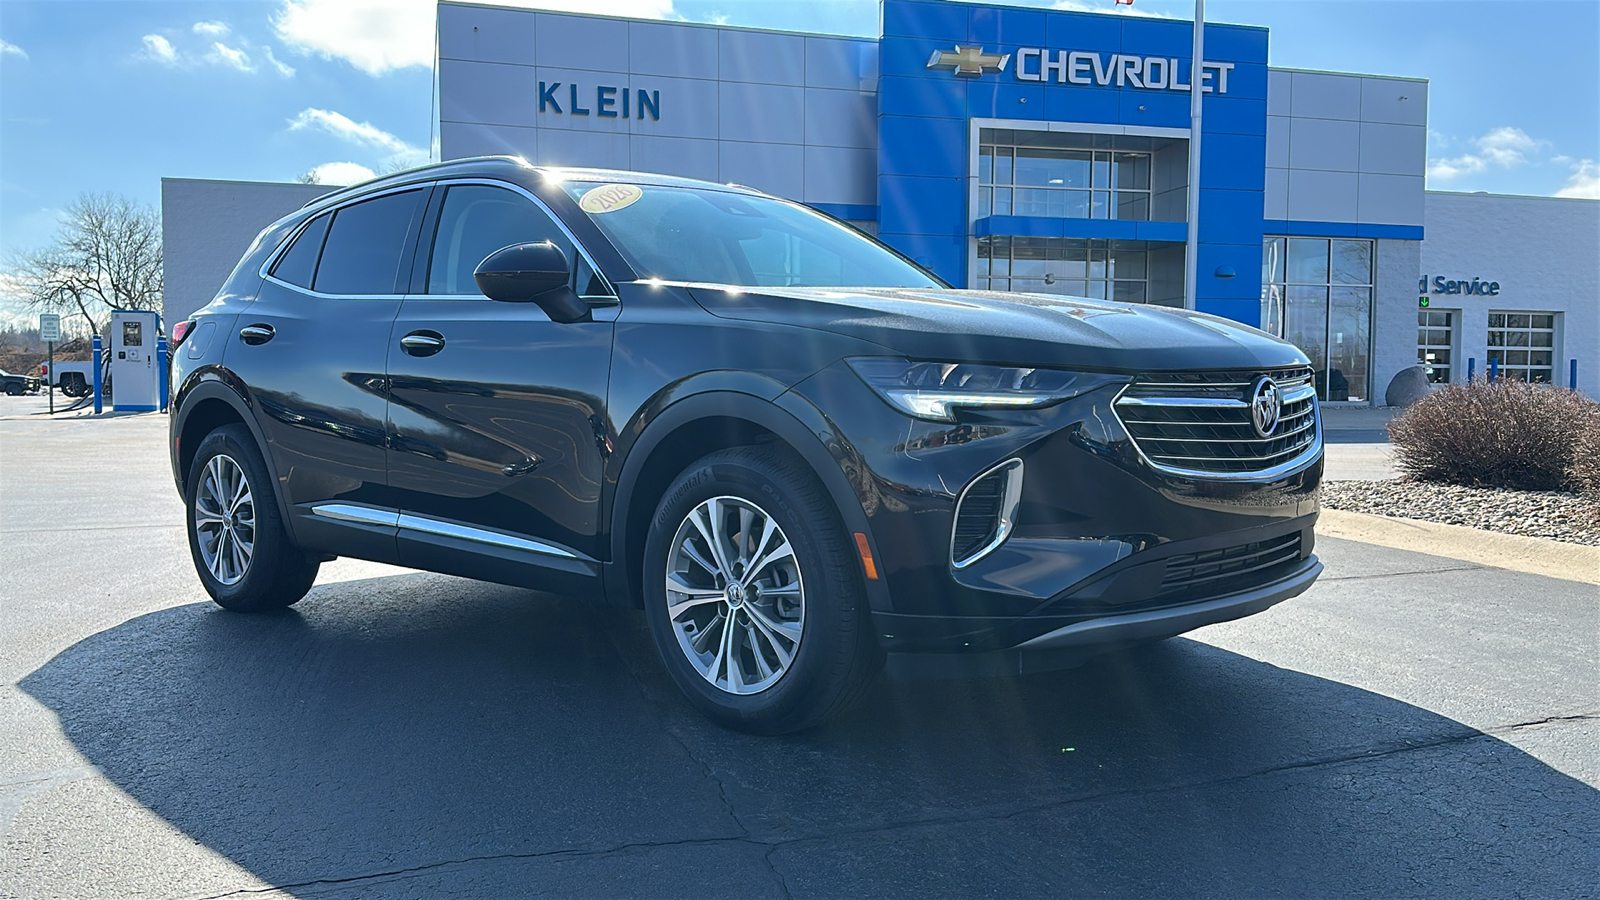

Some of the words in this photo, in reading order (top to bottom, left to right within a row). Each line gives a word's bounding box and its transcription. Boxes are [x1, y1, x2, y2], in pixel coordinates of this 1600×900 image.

[1016, 47, 1235, 93] CHEVROLET
[538, 81, 660, 121] KLEIN
[591, 186, 633, 209] 2026
[1433, 275, 1500, 296] Service
[656, 472, 703, 525] Continental
